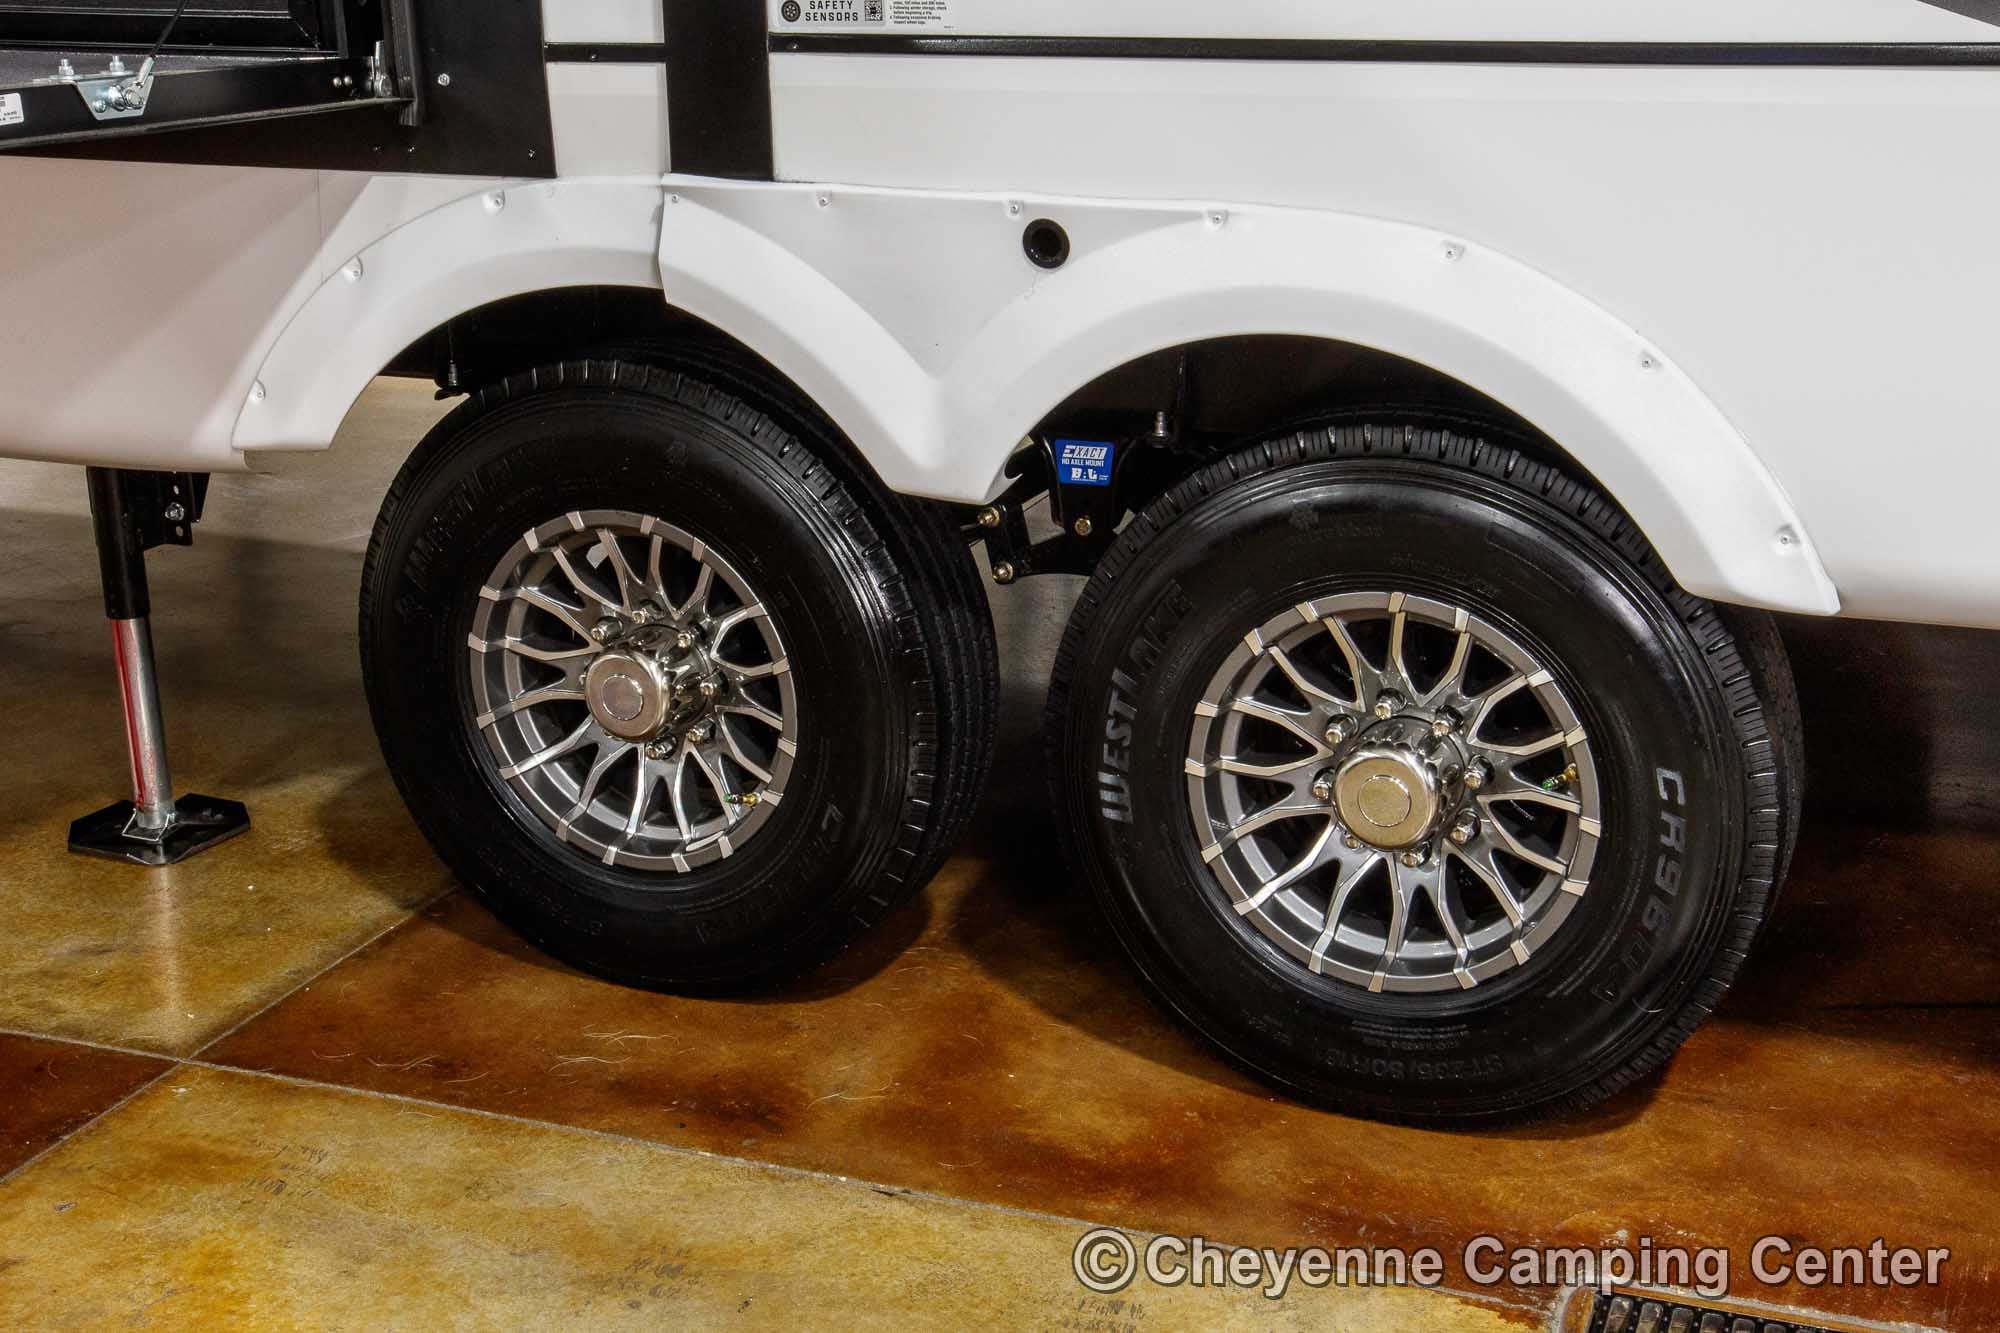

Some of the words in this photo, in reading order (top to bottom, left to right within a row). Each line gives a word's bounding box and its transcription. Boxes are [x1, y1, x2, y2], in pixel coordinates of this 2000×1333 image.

[810, 0, 853, 10] SAFETY
[805, 12, 859, 22] SENSORS
[1062, 444, 1108, 460] EXACT
[1071, 458, 1084, 466] AXLE
[1085, 459, 1105, 468] MOUNT
